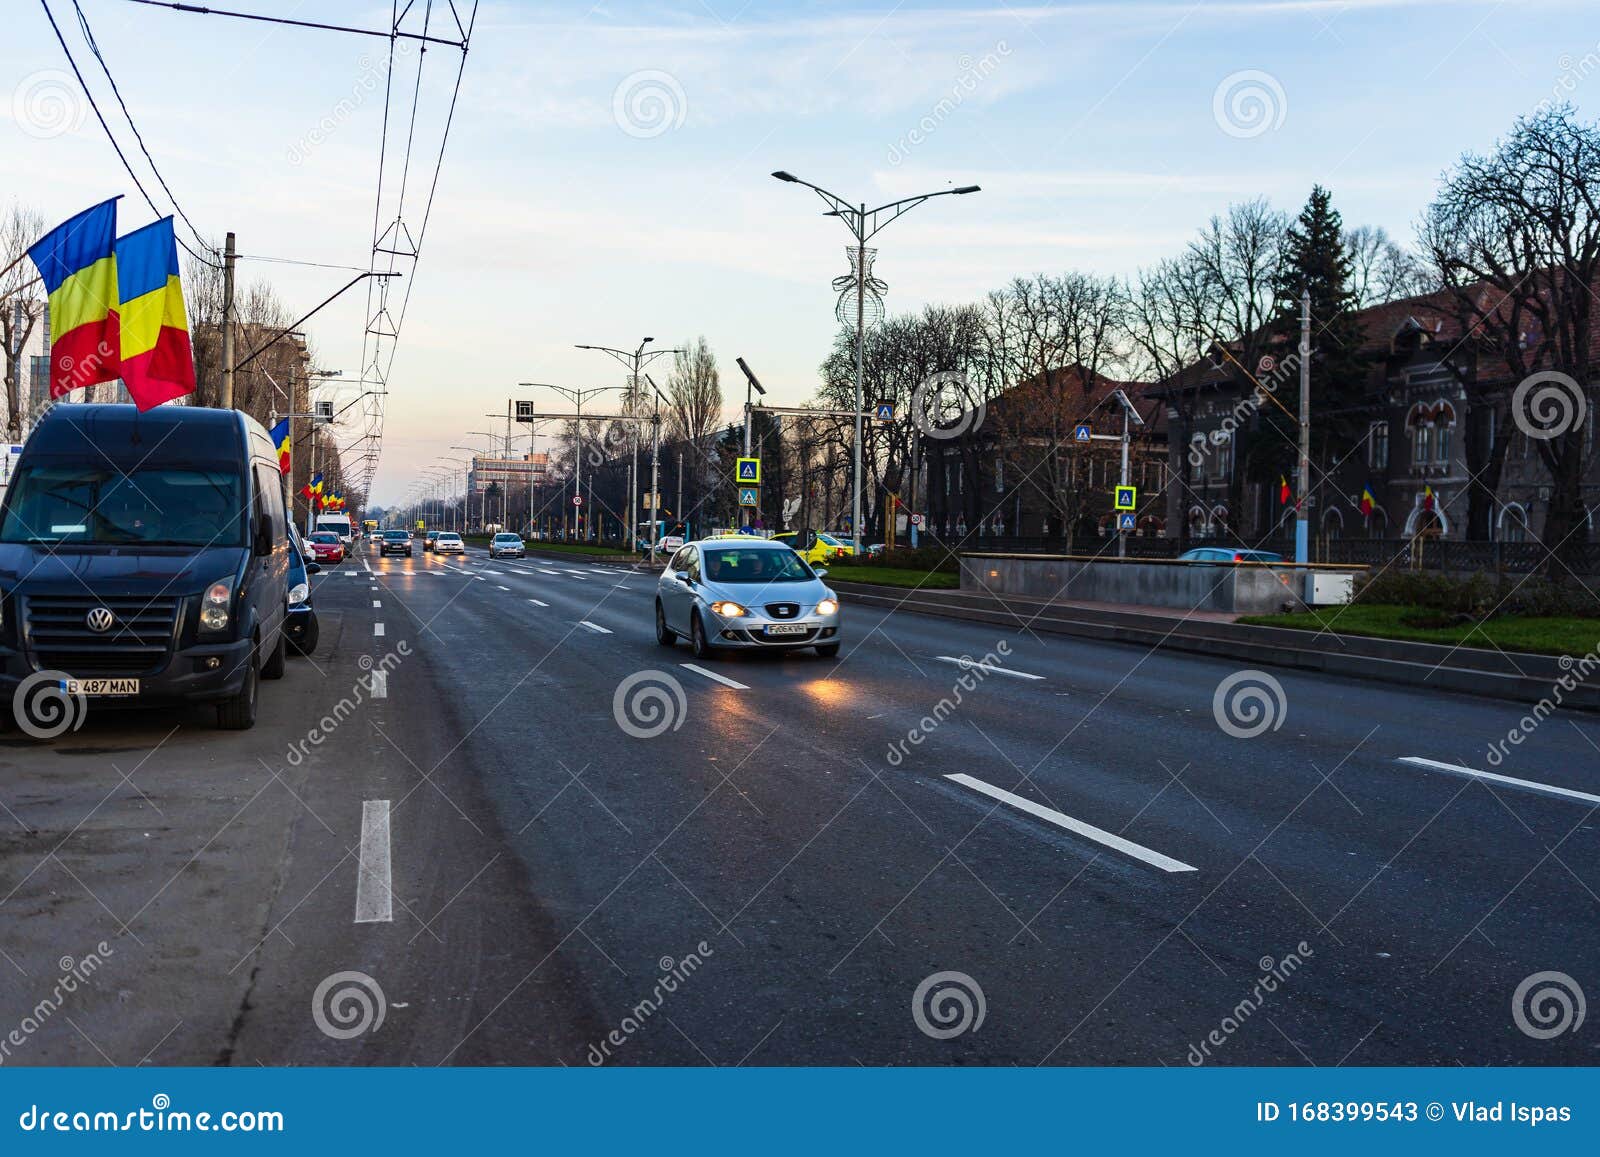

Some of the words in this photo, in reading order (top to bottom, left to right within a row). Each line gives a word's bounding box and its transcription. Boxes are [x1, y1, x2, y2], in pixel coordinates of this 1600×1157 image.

[68, 681, 78, 693] B
[83, 681, 107, 693] 487
[110, 681, 137, 693] MAN
